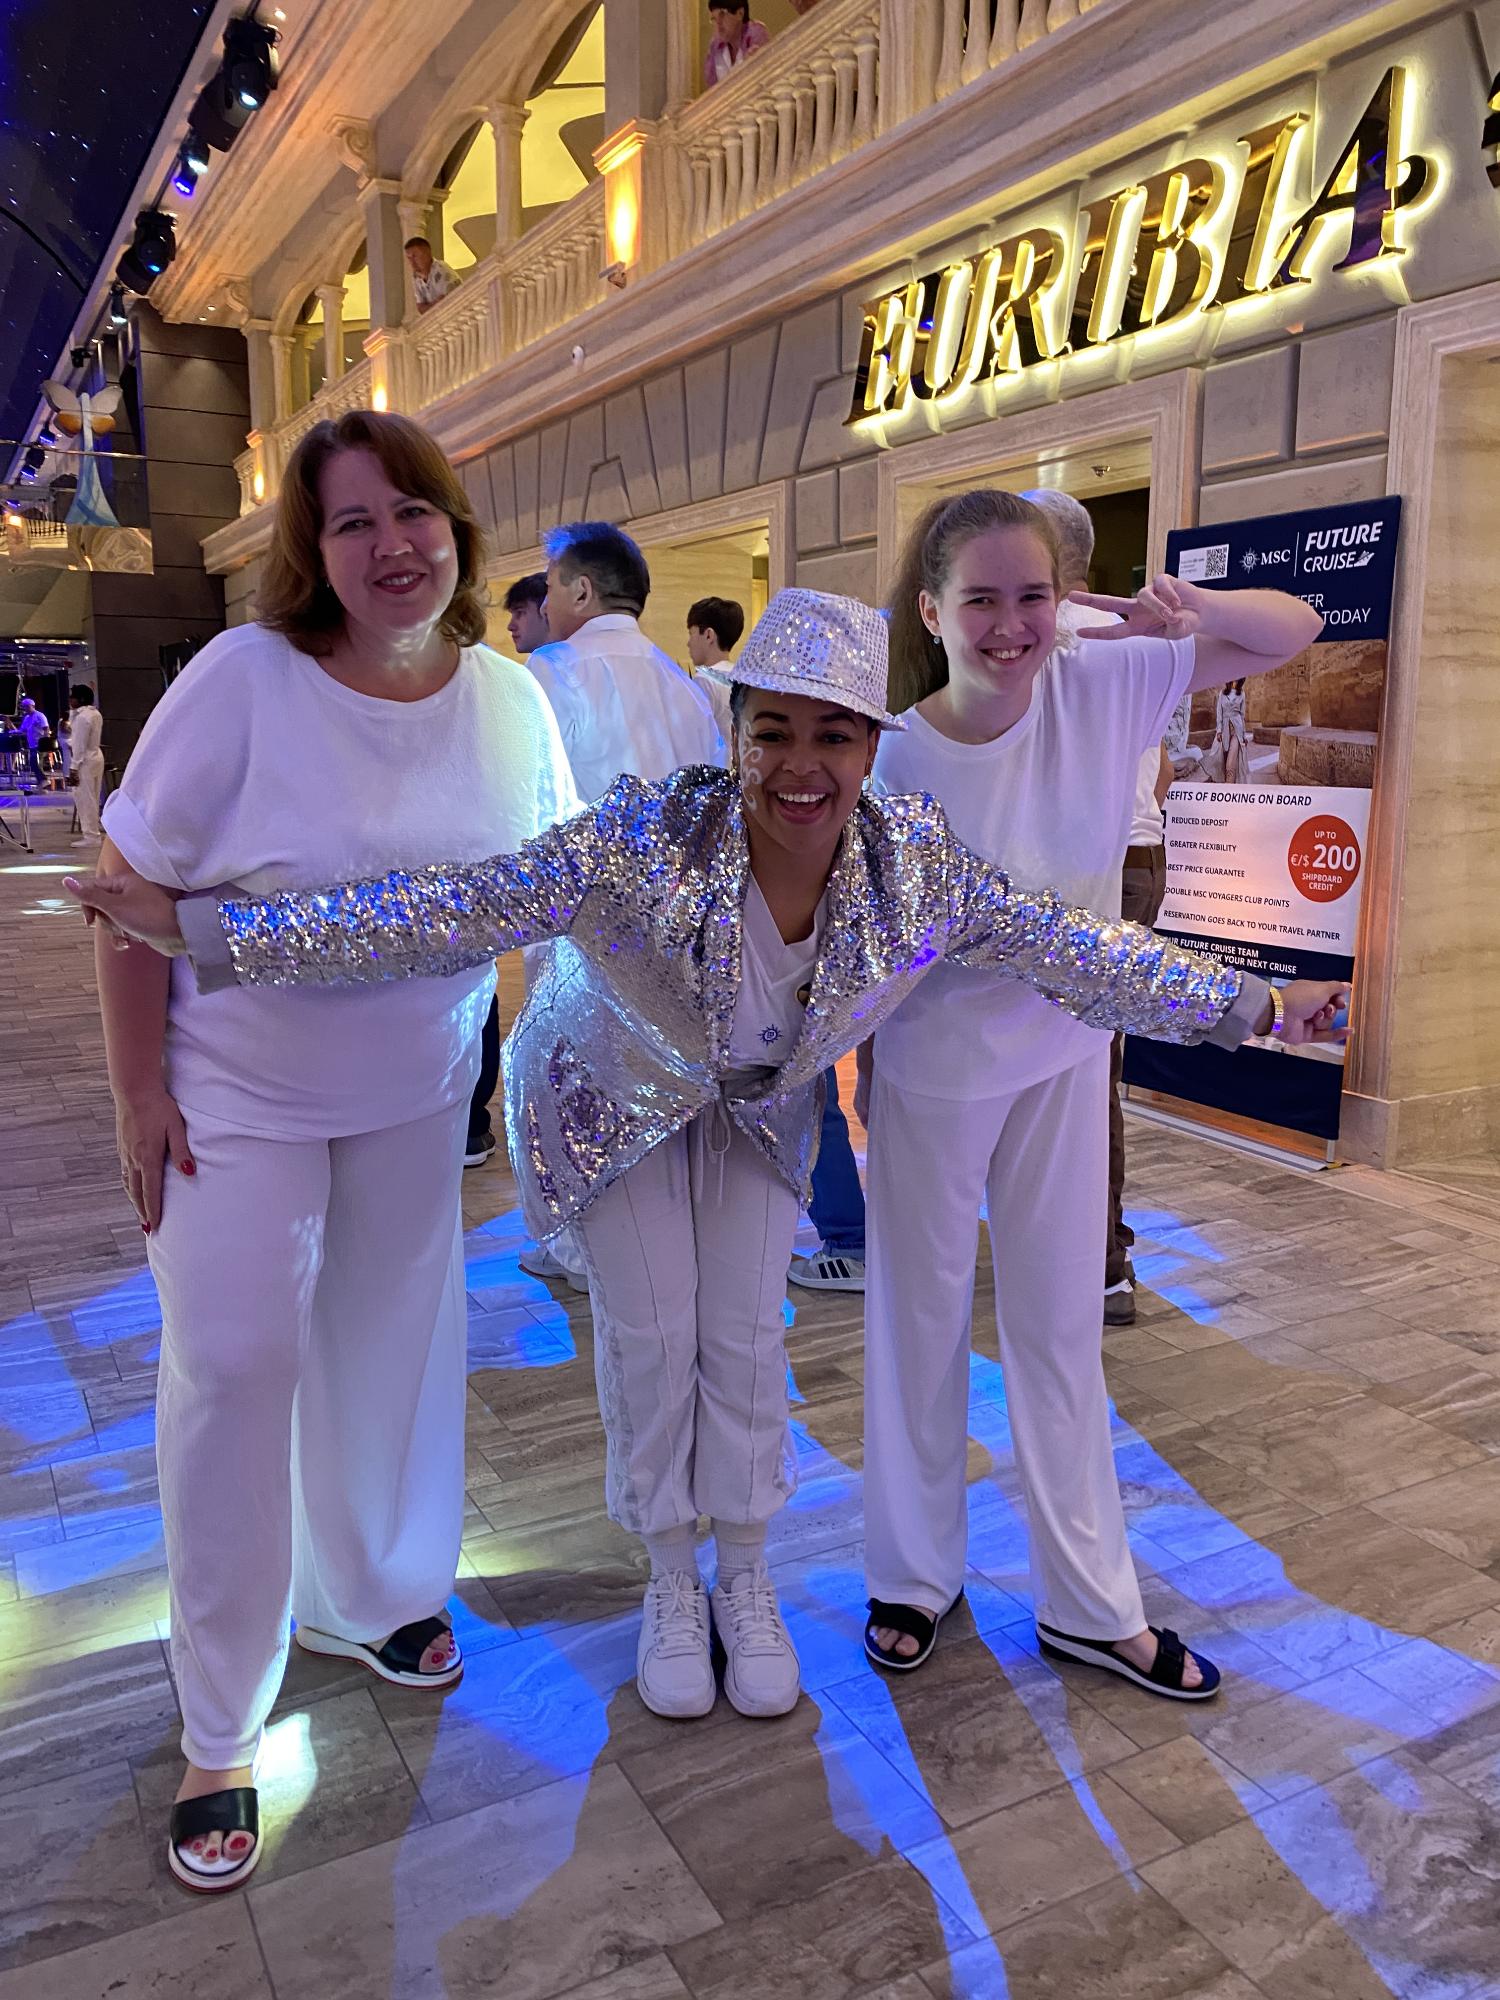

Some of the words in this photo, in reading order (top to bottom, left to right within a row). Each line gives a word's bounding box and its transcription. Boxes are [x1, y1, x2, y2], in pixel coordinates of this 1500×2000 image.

[842, 66, 1432, 427] EURIBIA
[1305, 521, 1383, 552] FUTURE
[1260, 549, 1291, 565] MSC
[1303, 551, 1357, 573] CRUISE
[1321, 607, 1371, 626] TODAY
[1195, 791, 1209, 802] OF
[1210, 792, 1256, 804] BOOKING
[1258, 794, 1274, 805] ON
[1276, 795, 1312, 806] BOARD
[1171, 816, 1200, 826] REDUCED
[1201, 818, 1229, 827] DEPOSIT
[1314, 830, 1325, 839] UP
[1326, 831, 1337, 840] TO
[1169, 840, 1198, 849] GREATER
[1199, 842, 1237, 853] FLEXIBILITY
[1312, 843, 1357, 871] 200
[1167, 863, 1183, 872] BEST
[1184, 865, 1204, 874] PRICE
[1204, 866, 1245, 878] GUARANTEE
[1301, 872, 1343, 884] SHIPBOARD
[1308, 882, 1334, 892] CREDIT
[1165, 886, 1192, 896] DOUBLE
[1192, 889, 1207, 898] MSC
[1208, 891, 1243, 902] VOYAGERS
[1244, 895, 1262, 905] CLUB
[1263, 897, 1290, 908] POINTS
[1163, 909, 1206, 922] RESERVATION
[1207, 915, 1225, 925] GOES
[1226, 918, 1245, 928] BACK
[1246, 920, 1256, 929] TO
[1257, 922, 1277, 932] YOUR
[1279, 925, 1305, 936] TRAVEL
[1306, 928, 1340, 941] PARTNER
[1180, 938, 1209, 951] FUTURE
[1210, 943, 1236, 954] CRUISE
[1237, 947, 1259, 958] TEAM
[1200, 951, 1223, 962] BOOK
[1224, 954, 1245, 966] YOUR
[1246, 958, 1268, 970] NEXT
[1269, 961, 1297, 975] CRUISE
